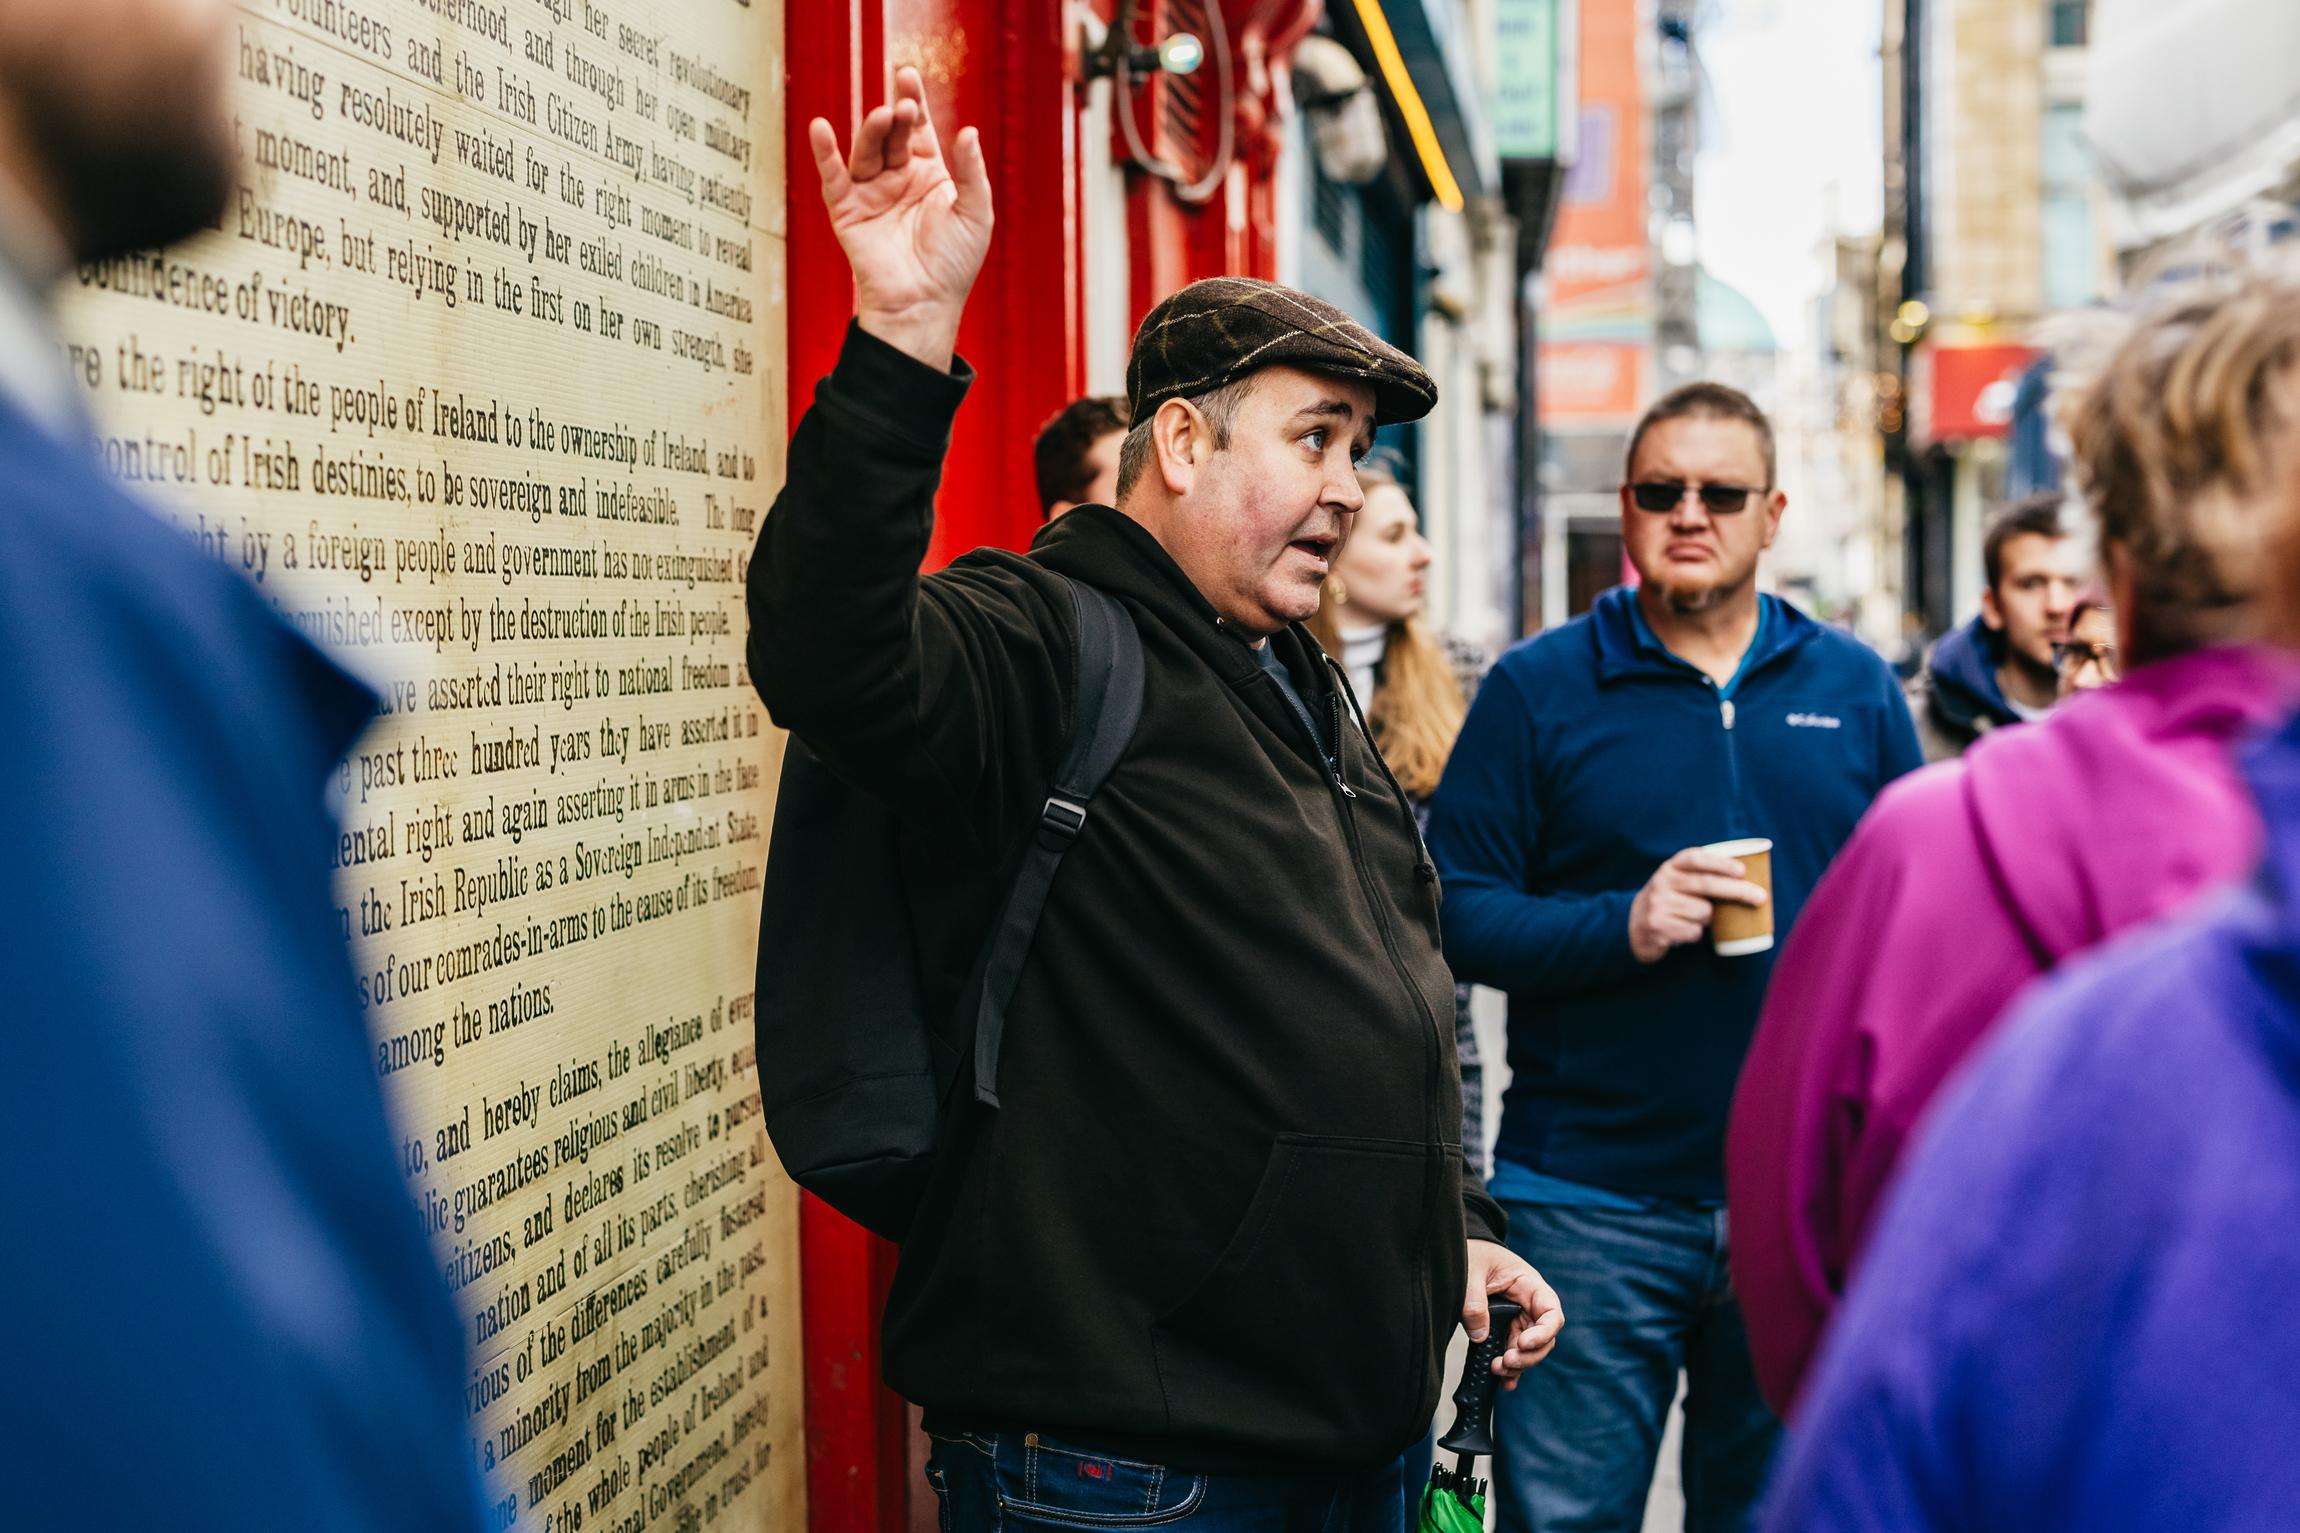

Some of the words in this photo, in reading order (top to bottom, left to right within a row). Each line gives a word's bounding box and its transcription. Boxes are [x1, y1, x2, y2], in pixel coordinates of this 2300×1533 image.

[525, 29, 555, 72] and
[565, 42, 624, 111] through
[636, 76, 659, 122] her
[667, 103, 696, 141] open
[584, 0, 609, 40] her
[619, 21, 661, 68] secret
[239, 23, 324, 120] having
[340, 80, 444, 165] resolutely
[455, 127, 515, 182] waited
[525, 146, 549, 195] for
[560, 161, 585, 209] the
[595, 179, 632, 230] right
[641, 205, 692, 250] moment
[699, 228, 711, 258] to
[408, 37, 443, 85] and
[455, 50, 485, 102] the
[497, 66, 537, 126] Irish
[547, 91, 598, 153] Citizen
[604, 120, 647, 183] Army,
[652, 140, 694, 204] having
[237, 185, 331, 271] Europe,
[340, 217, 376, 274] but
[388, 239, 458, 308] relying
[466, 256, 484, 305] in
[493, 266, 522, 315] the
[530, 275, 564, 325] first
[574, 299, 592, 333] on
[599, 295, 624, 341] her
[633, 318, 662, 351] own
[255, 128, 356, 201] moment,
[368, 163, 411, 221] and,
[421, 186, 511, 247] supported
[519, 206, 538, 264] by
[545, 216, 571, 266] her
[580, 236, 623, 282] exiled
[632, 250, 684, 303] children
[689, 270, 701, 308] in
[237, 270, 260, 322] of
[268, 276, 355, 354] victory.
[117, 333, 165, 395] the
[177, 344, 245, 416] right
[252, 358, 274, 411] of
[283, 362, 321, 417] the
[330, 379, 398, 438] people
[406, 386, 425, 433] of
[432, 389, 499, 444] Ireland
[505, 404, 521, 448] to
[528, 407, 555, 453] the
[560, 422, 637, 474] ownership
[643, 429, 657, 467] of
[717, 444, 739, 480] and
[207, 433, 234, 485] of
[242, 434, 300, 491] Irish
[312, 444, 412, 509] destinies,
[416, 459, 436, 504] to
[443, 460, 464, 506] be
[470, 470, 552, 524] sovereign
[559, 477, 587, 517] and
[595, 479, 680, 527] indefeasible.
[240, 516, 271, 584] by
[283, 532, 299, 570] a
[308, 520, 387, 583] foreign
[395, 527, 456, 585] people
[463, 531, 497, 575] and
[502, 540, 598, 586] government
[602, 540, 628, 581] has
[632, 551, 653, 581] not
[655, 545, 733, 591] extinguished
[391, 600, 456, 654] except
[460, 596, 482, 653] by
[489, 597, 516, 643] the
[520, 597, 608, 641] destruction
[612, 599, 628, 638] of
[630, 599, 651, 638] the
[655, 599, 685, 639] Irish
[507, 661, 547, 706] their
[552, 660, 591, 711] right
[595, 660, 611, 699] to
[618, 654, 674, 697] national
[682, 654, 731, 691] freedom
[360, 741, 405, 805] past
[471, 723, 540, 776] hundred
[550, 729, 591, 775] years
[600, 716, 630, 766] they
[639, 713, 671, 753] have
[406, 803, 454, 864] right
[463, 794, 496, 845] and
[502, 788, 549, 845] again
[557, 777, 625, 824] asserting
[630, 773, 640, 812] it
[645, 770, 659, 809] in
[663, 773, 696, 805] arms
[697, 762, 711, 799] in
[715, 758, 733, 795] the
[360, 886, 392, 939] the
[400, 872, 448, 928] Irish
[454, 856, 529, 919] Republic
[536, 858, 554, 893] as
[559, 855, 570, 886] a
[575, 833, 642, 881] Sovereign
[373, 953, 397, 1007] of
[399, 955, 433, 999] our
[436, 909, 589, 987] comrades-in-arms
[592, 902, 607, 940] to
[610, 890, 633, 933] the
[636, 889, 674, 925] cause
[676, 873, 690, 912] of
[692, 872, 709, 908] its
[379, 1020, 446, 1078] among
[453, 1000, 482, 1050] the
[487, 980, 555, 1036] nations.
[402, 1134, 429, 1180] to,
[436, 1104, 472, 1164] and
[483, 1080, 542, 1142] hereby
[549, 1057, 603, 1109] claims,
[608, 1039, 631, 1082] the
[638, 1014, 704, 1067] allegiance
[710, 994, 723, 1034] of
[443, 1230, 517, 1294] citizens,
[523, 1192, 555, 1250] and
[564, 1164, 624, 1225] declares
[633, 1146, 652, 1185] its
[656, 1120, 700, 1172] resolve
[708, 1112, 720, 1142] to
[454, 1146, 550, 1235] guarantees
[554, 1109, 619, 1168] religious
[622, 1083, 649, 1133] and
[651, 1068, 680, 1118] civil
[475, 1281, 531, 1347] nation
[536, 1248, 567, 1306] and
[574, 1233, 590, 1280] of
[593, 1218, 614, 1268] all
[618, 1212, 637, 1255] its
[517, 1329, 534, 1385] of
[540, 1319, 567, 1369] the
[570, 1268, 649, 1346] differences
[656, 1218, 713, 1286] carefully
[484, 1439, 497, 1474] a
[500, 1381, 572, 1462] minority
[576, 1353, 613, 1406] from
[615, 1330, 638, 1375] the
[641, 1289, 698, 1355] majority
[717, 1260, 737, 1298] the
[527, 1425, 594, 1511] moment
[596, 1410, 618, 1455] for
[622, 1387, 646, 1432] the
[650, 1316, 737, 1409] establishment
[742, 1293, 755, 1334] of
[556, 1501, 583, 1533] the
[587, 1454, 631, 1518] whole
[638, 1412, 681, 1488] people
[683, 1392, 697, 1436] of
